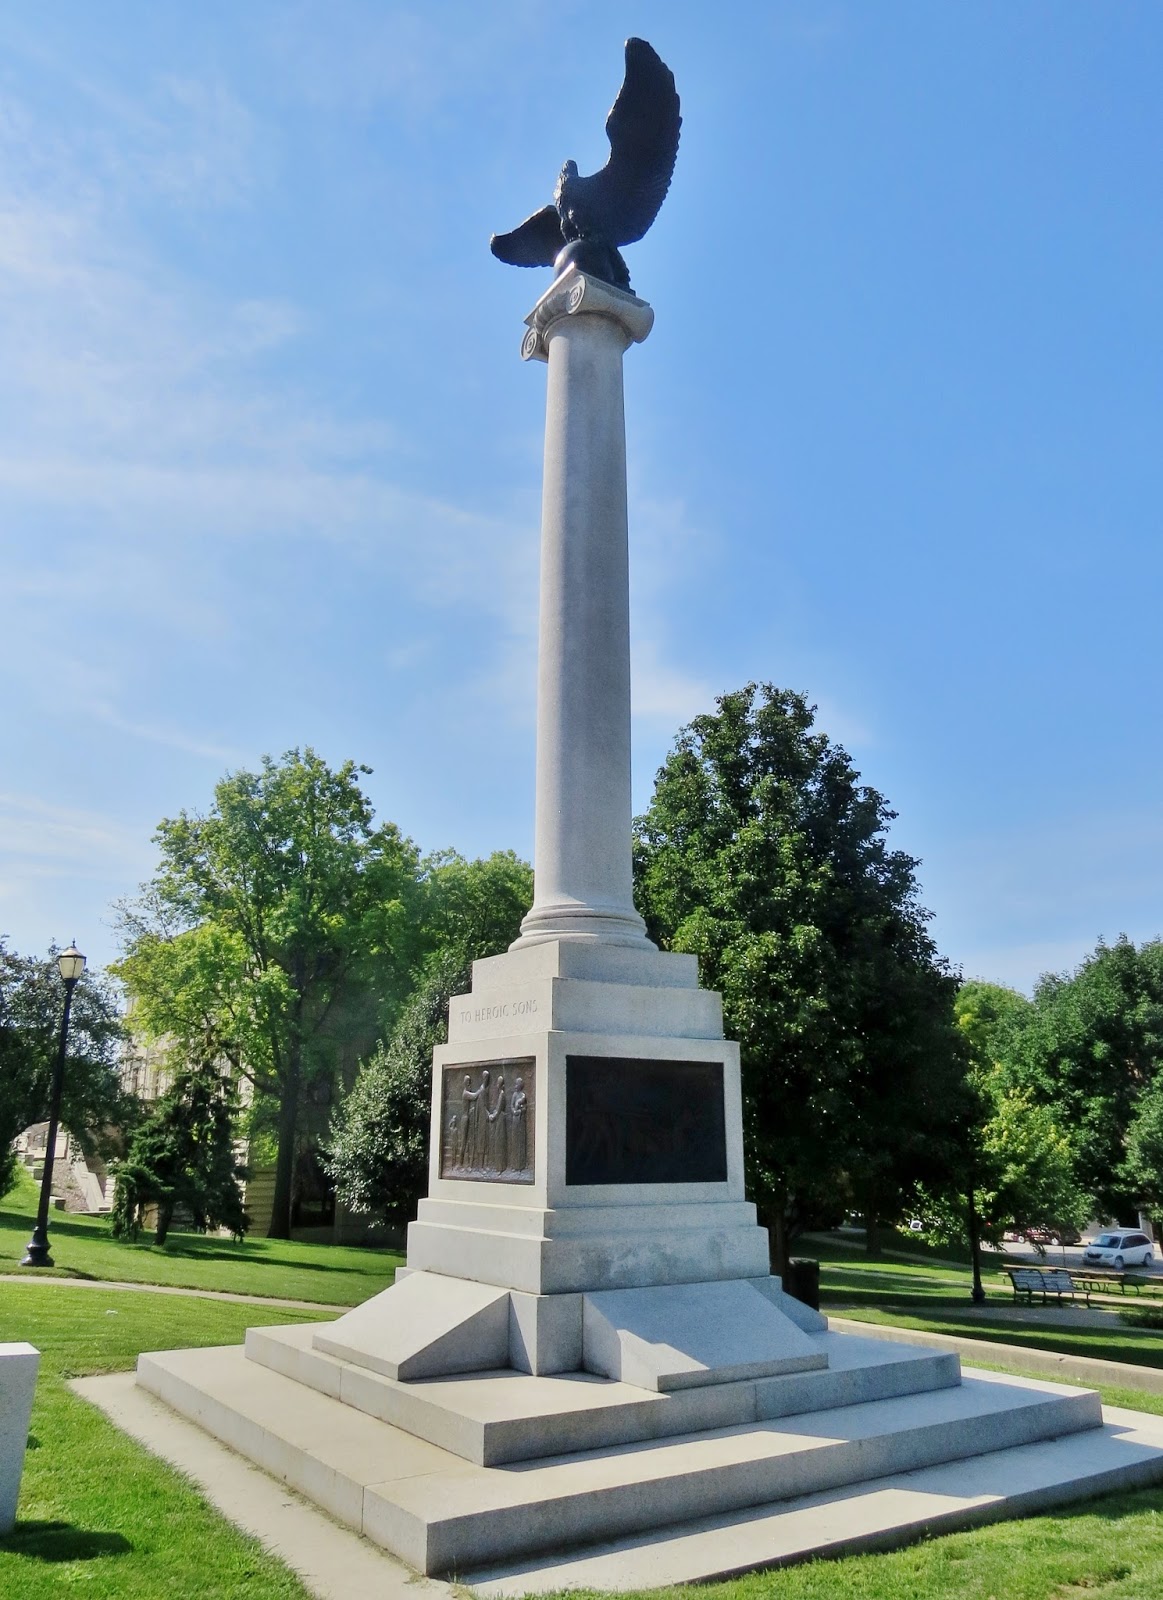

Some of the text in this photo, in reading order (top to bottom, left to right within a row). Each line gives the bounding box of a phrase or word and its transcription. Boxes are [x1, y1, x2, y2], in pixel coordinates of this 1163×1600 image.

[460, 999, 538, 1024] TO HEROIC SONS
